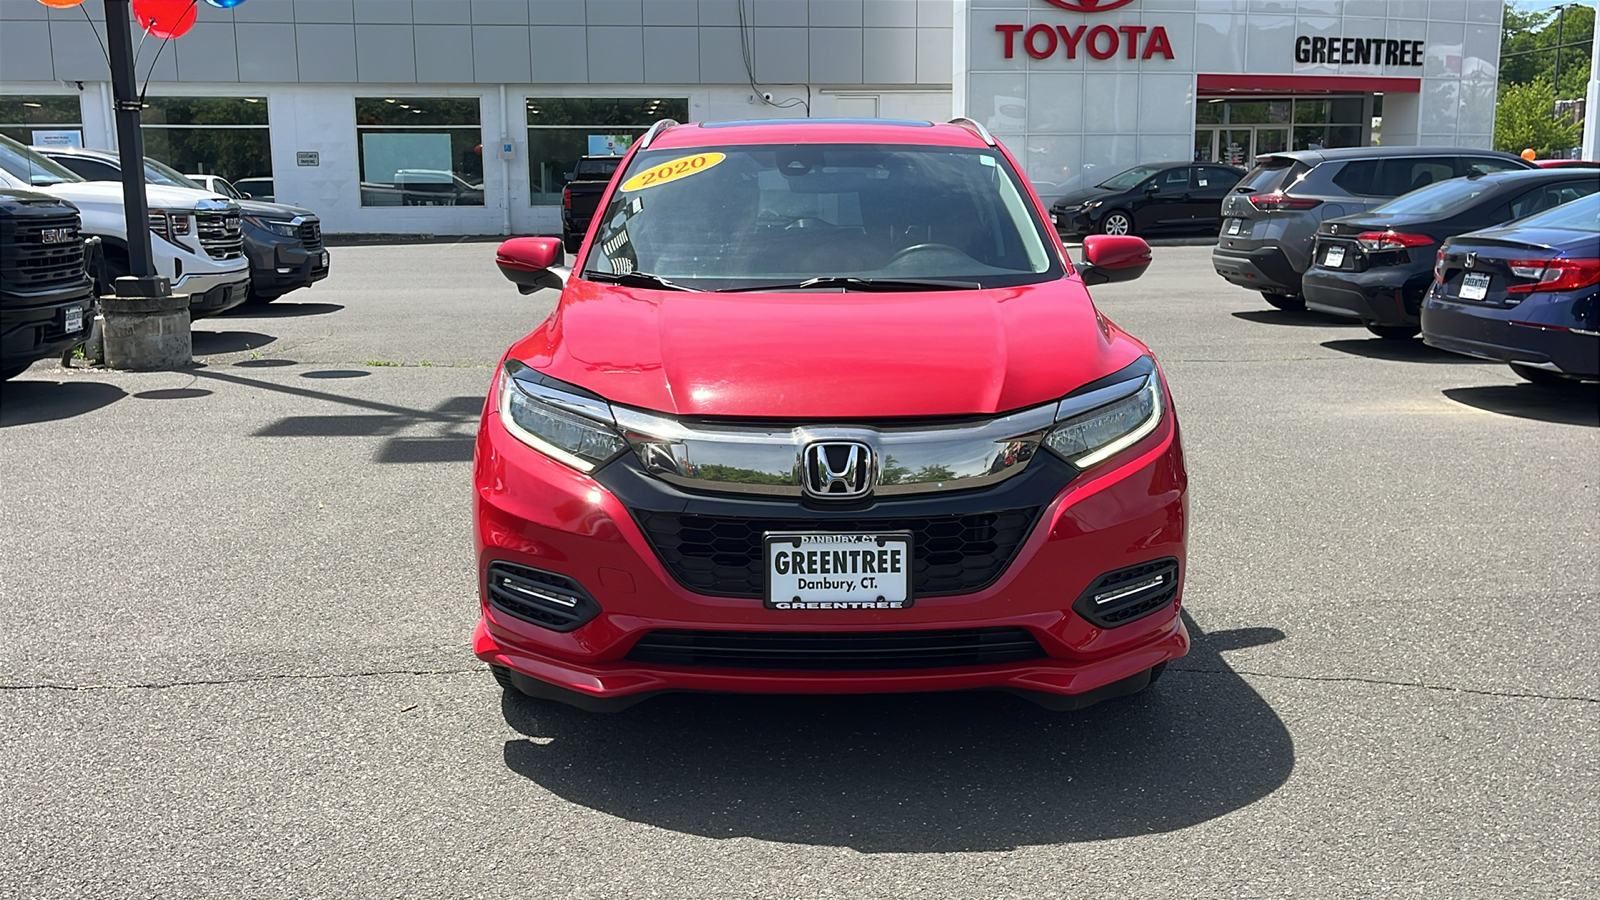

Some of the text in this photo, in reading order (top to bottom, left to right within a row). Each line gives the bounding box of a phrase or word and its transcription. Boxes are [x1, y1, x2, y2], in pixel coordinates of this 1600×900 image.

[995, 24, 1174, 60] TOYOTA
[1295, 36, 1424, 66] GREENTREE
[641, 156, 706, 186] 2020
[42, 228, 74, 244] GMC
[775, 550, 901, 575] GREENTREE
[798, 577, 878, 592] Danbury, CT.
[775, 601, 903, 609] GREENTREE
